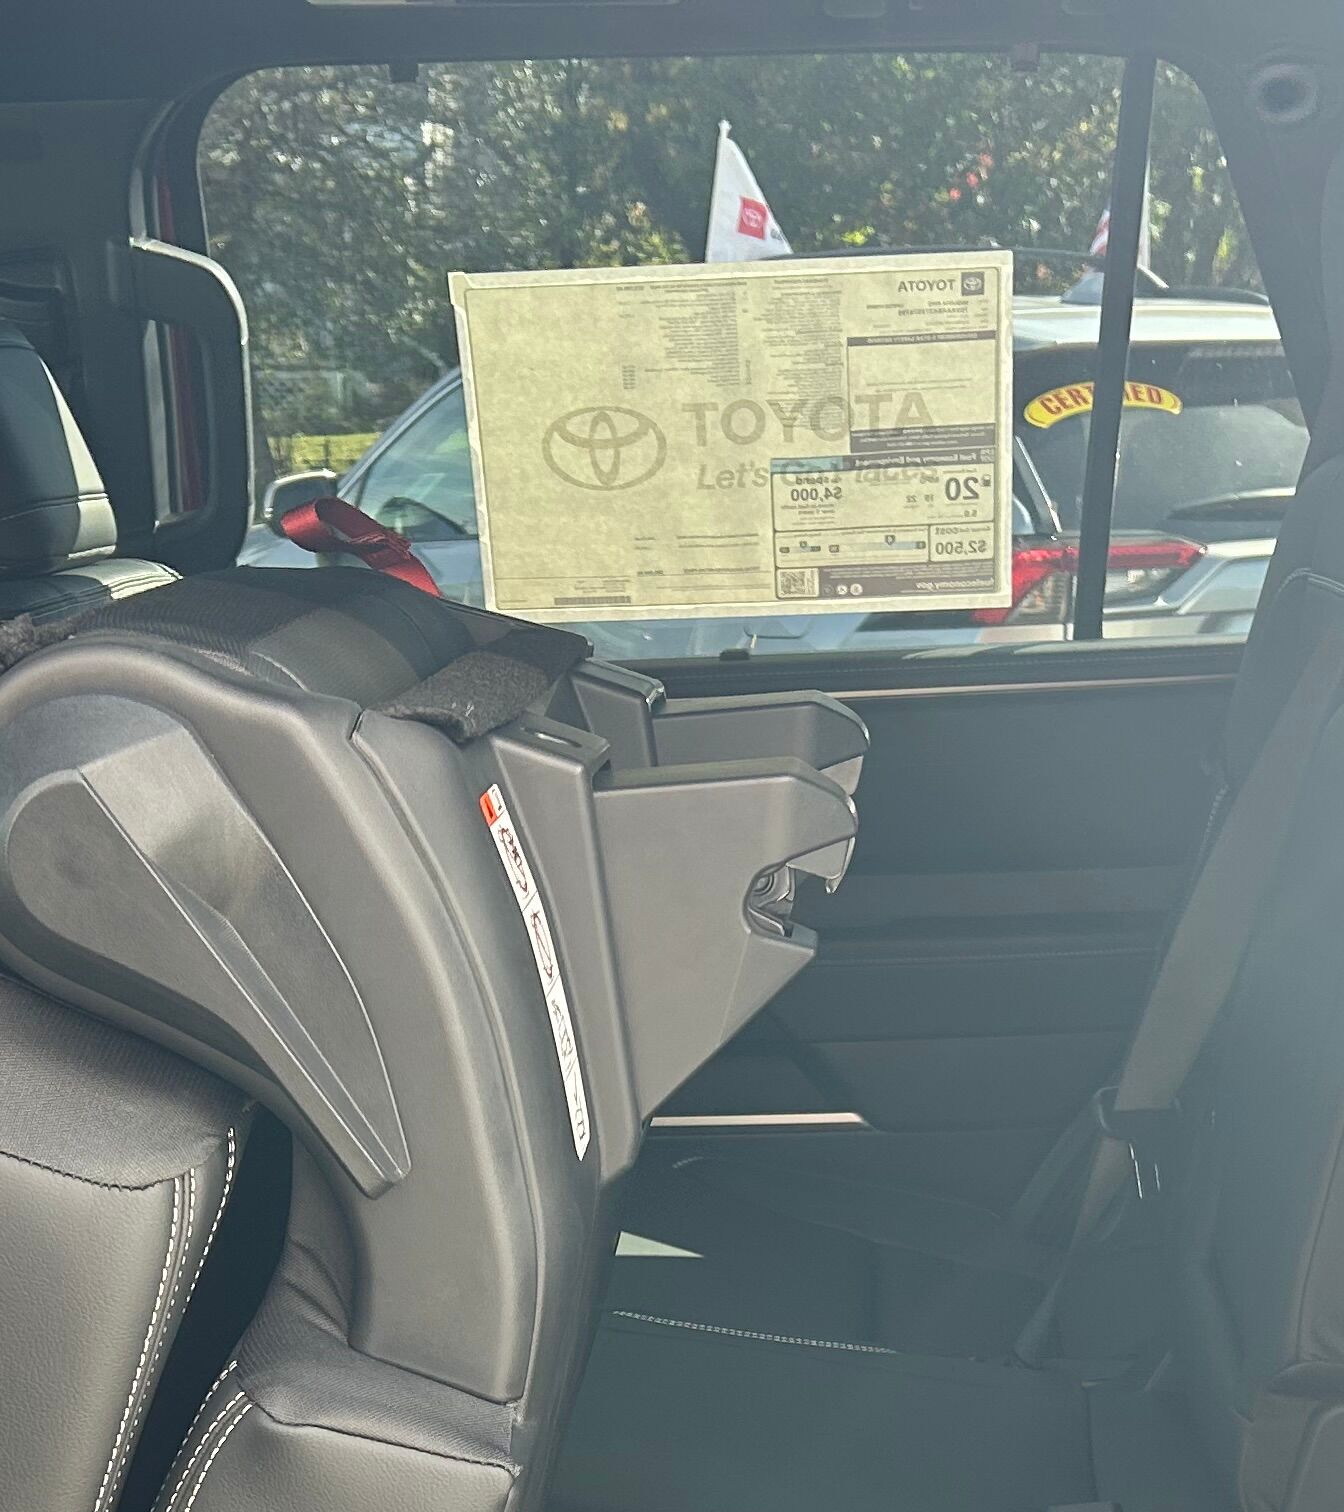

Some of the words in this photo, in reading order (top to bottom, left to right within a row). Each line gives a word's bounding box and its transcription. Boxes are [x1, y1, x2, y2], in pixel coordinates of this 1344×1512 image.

[1039, 383, 1162, 415] CERED
[682, 392, 935, 448] TOYOTA
[697, 461, 768, 491] Let's
